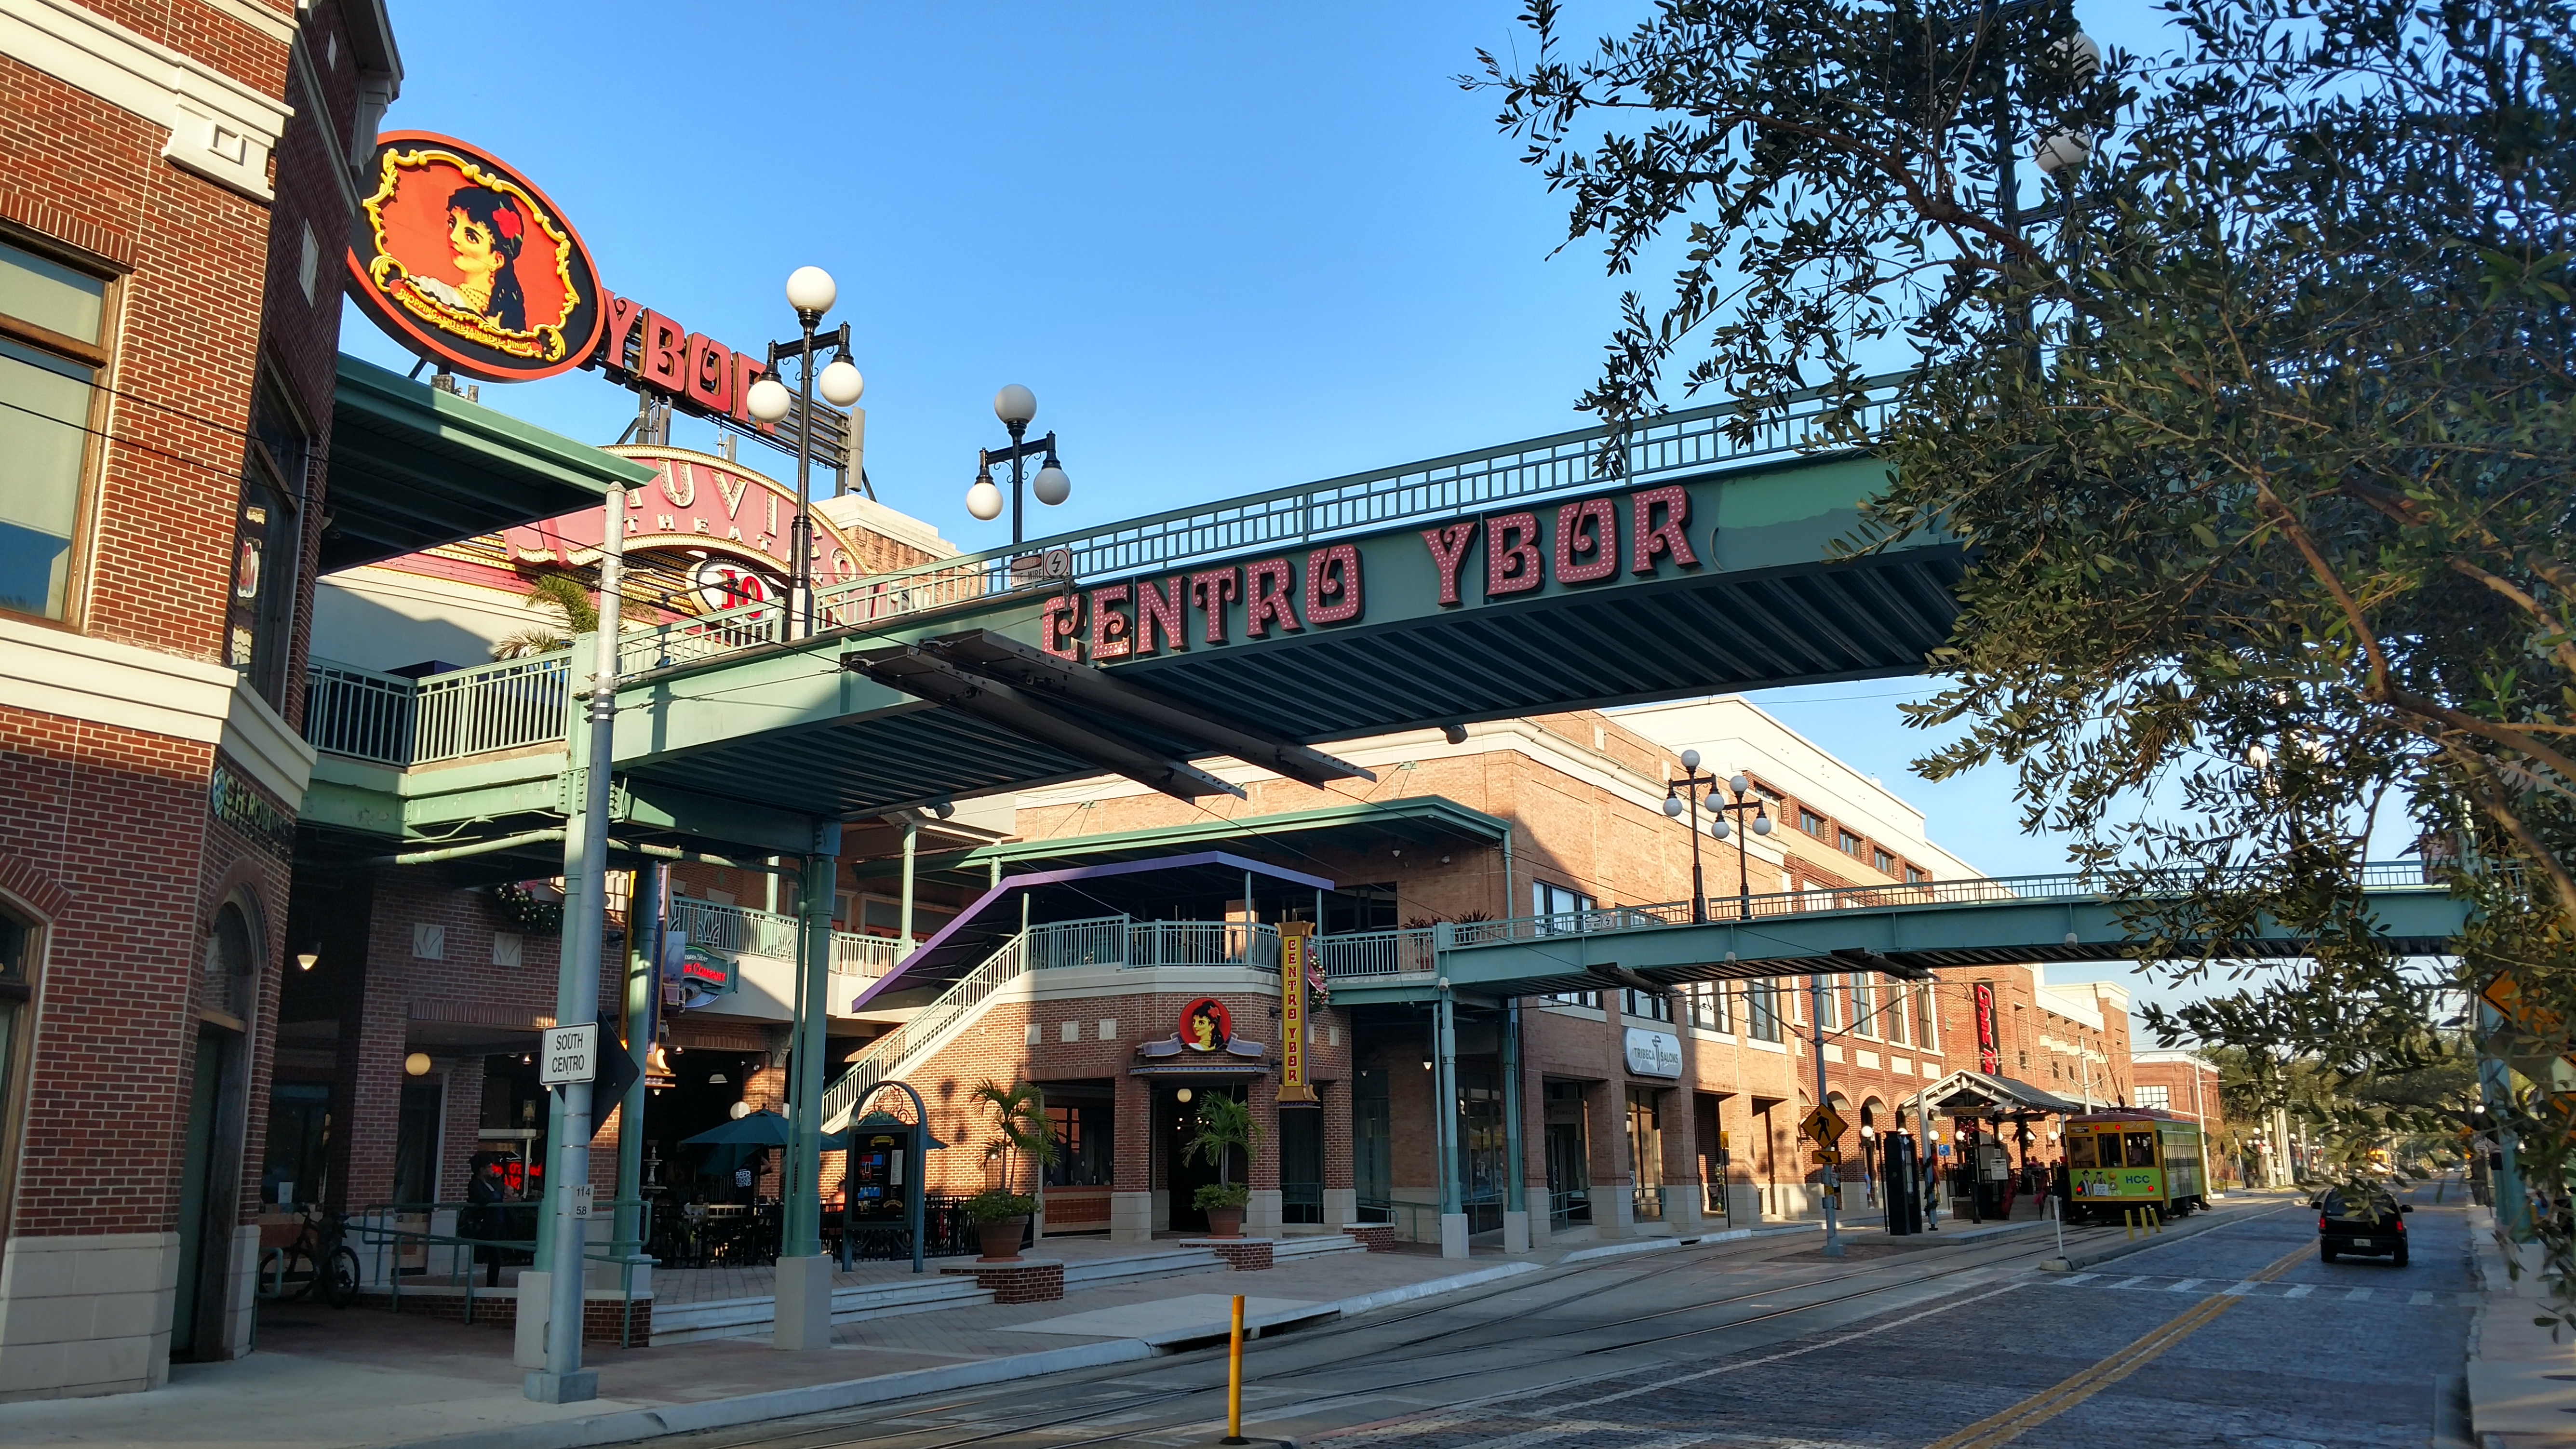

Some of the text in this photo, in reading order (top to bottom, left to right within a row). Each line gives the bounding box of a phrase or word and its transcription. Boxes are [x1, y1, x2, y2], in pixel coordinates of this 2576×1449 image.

[398, 288, 532, 350] SHOPPING ENTERTAINMENT DINING
[626, 458, 857, 582] UVIO
[1016, 558, 1037, 568] DANGER
[1010, 569, 1042, 584] LIVE WIRE
[1042, 485, 1703, 661] CENTRO YBOR
[721, 569, 764, 619] 10
[1288, 939, 1298, 1083] CENTRO YBOR
[556, 1033, 583, 1051] SOUTH
[551, 1054, 585, 1073] CENTRO
[1634, 1047, 1678, 1064] TRIBECA SALONS
[2126, 1175, 2150, 1184] HCC
[576, 1187, 590, 1197] 114
[576, 1206, 587, 1215] 58
